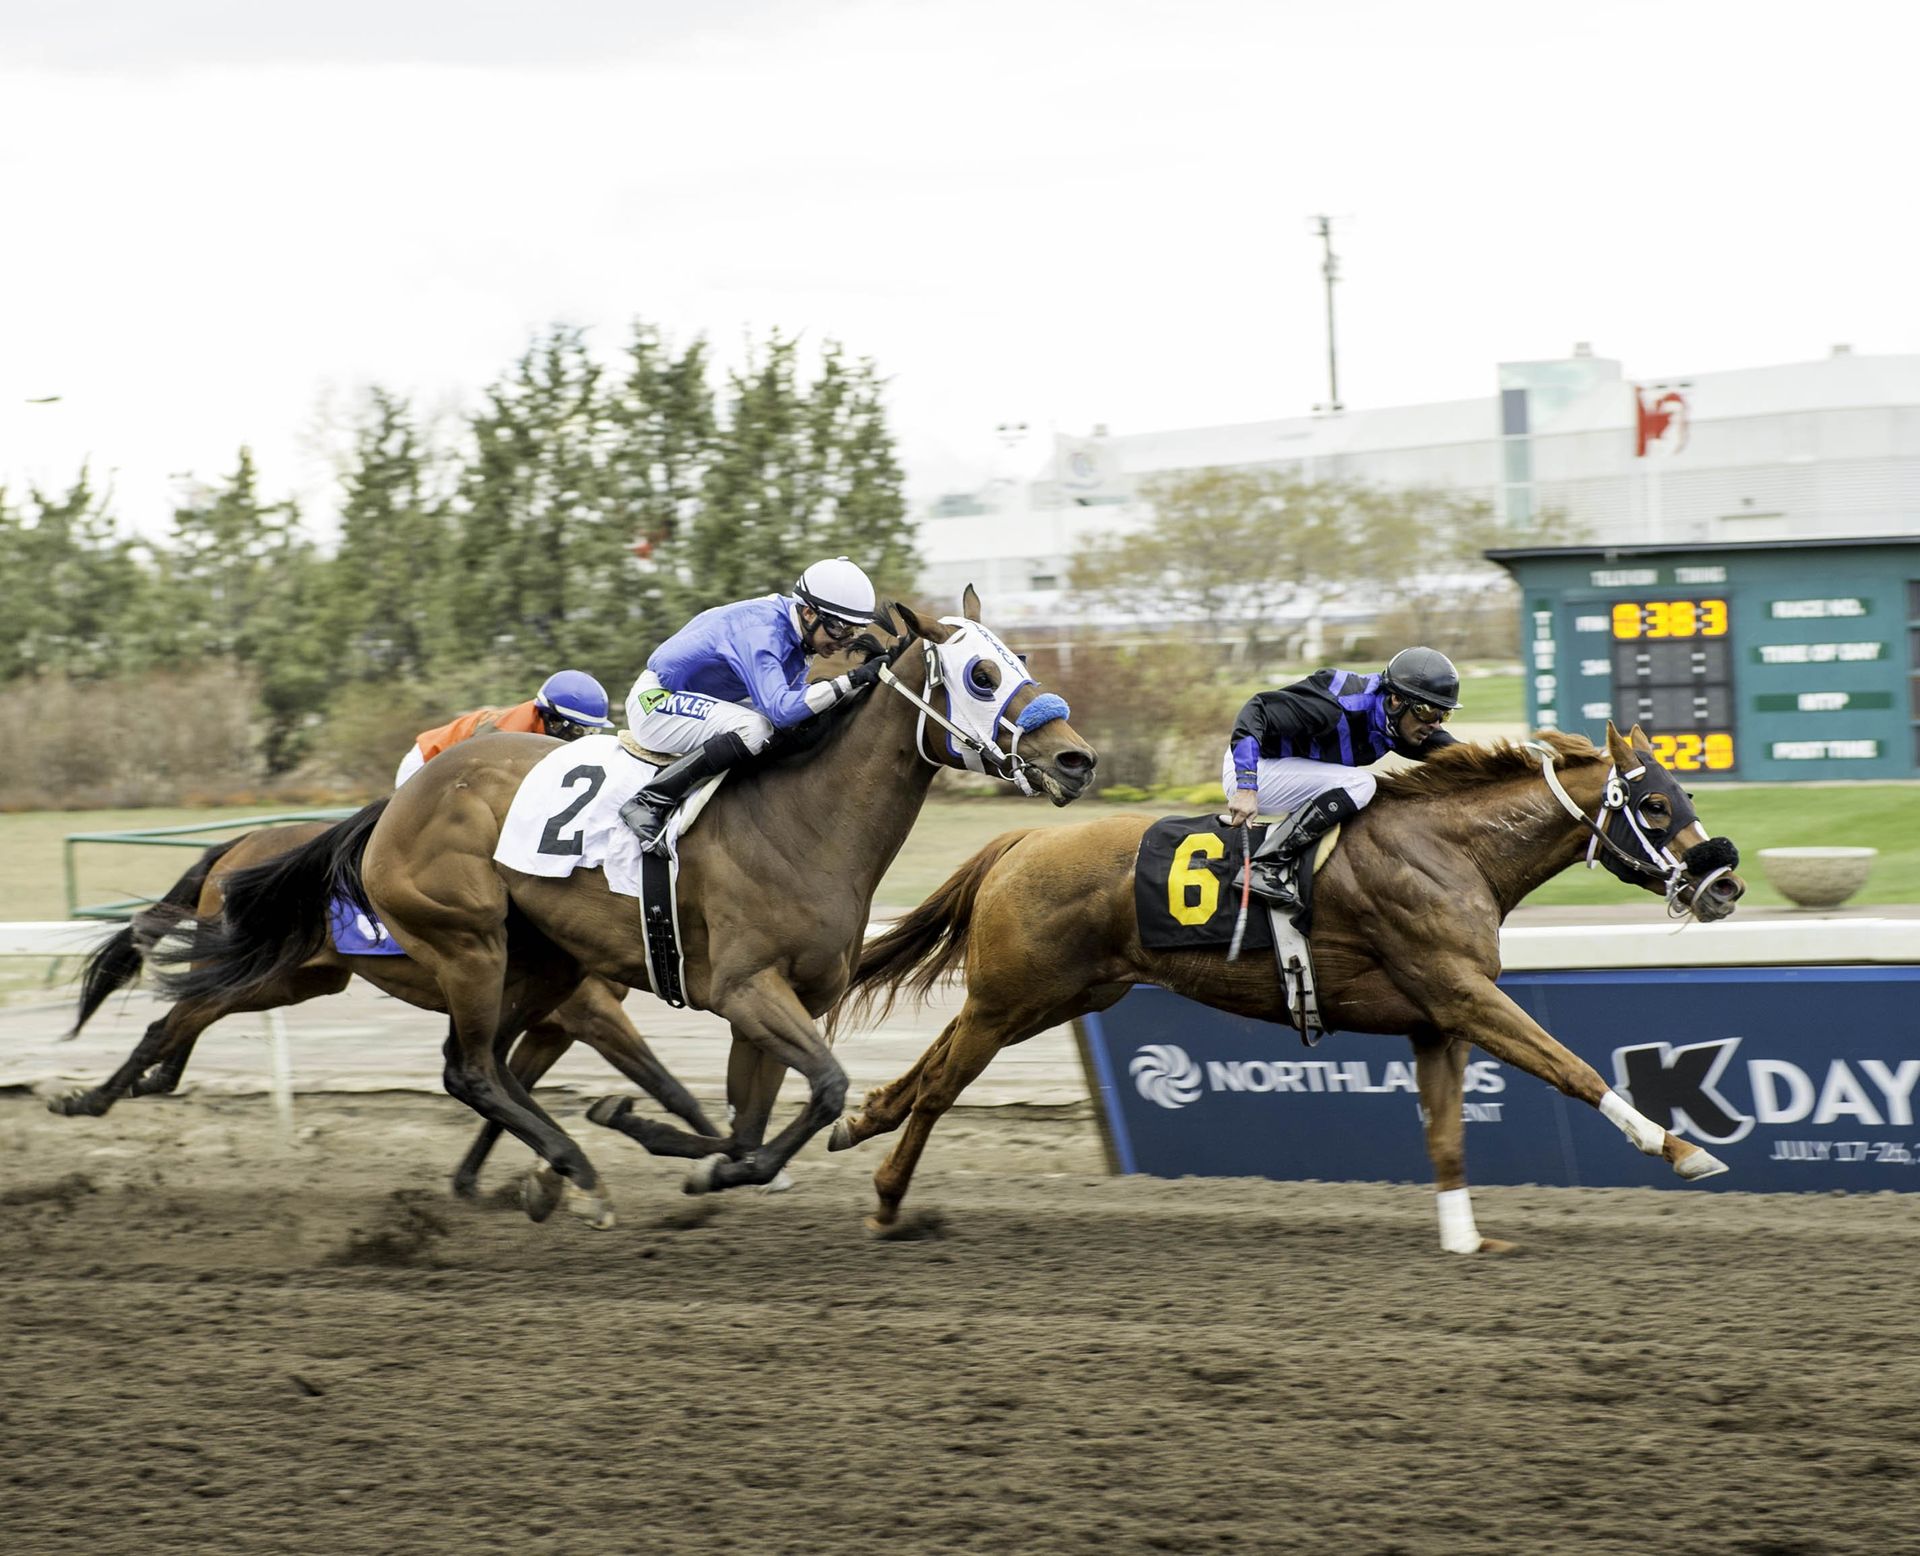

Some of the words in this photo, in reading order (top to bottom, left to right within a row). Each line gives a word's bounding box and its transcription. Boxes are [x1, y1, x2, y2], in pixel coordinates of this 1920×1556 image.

[926, 649, 939, 685] 2
[537, 764, 607, 856] 2
[1606, 779, 1625, 808] 6
[1168, 832, 1224, 926] 6
